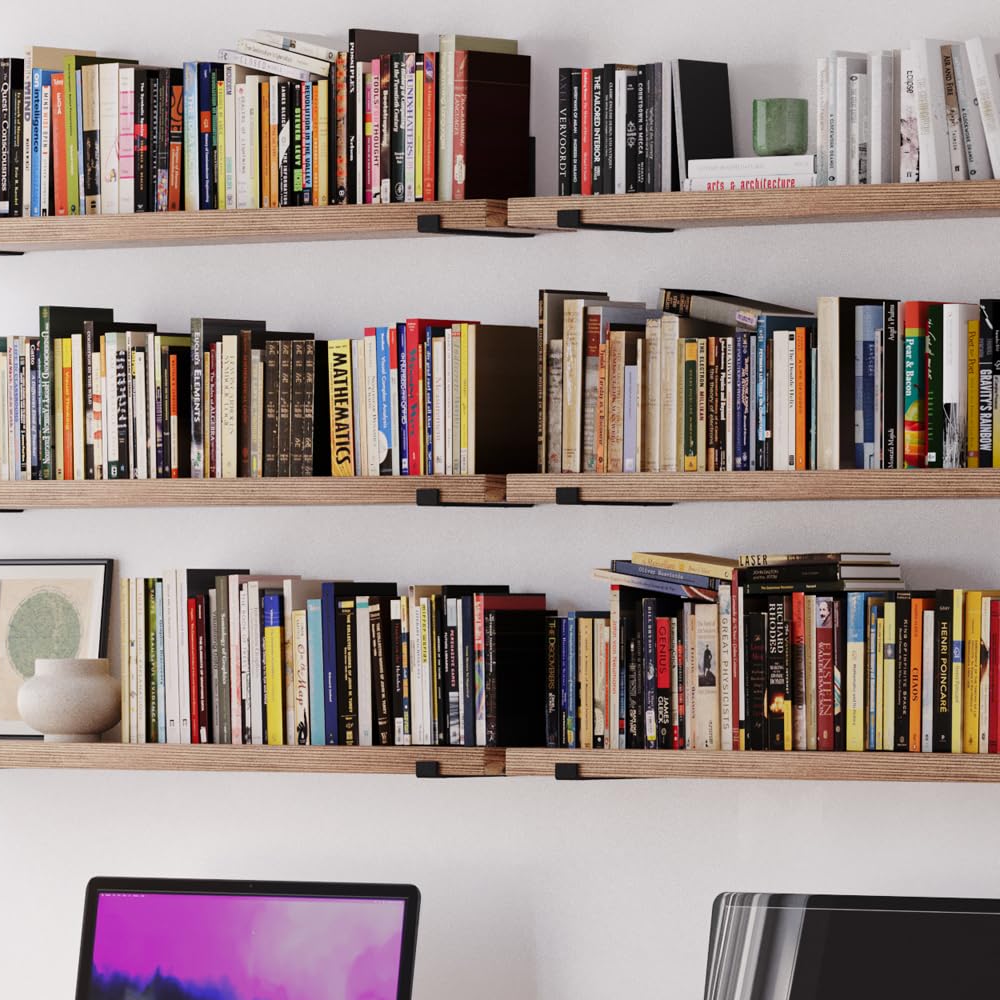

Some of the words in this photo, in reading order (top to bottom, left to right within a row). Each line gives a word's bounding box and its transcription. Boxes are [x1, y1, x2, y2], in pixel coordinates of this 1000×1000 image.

[0, 82, 9, 111] Quest
[34, 73, 40, 87] on
[946, 83, 954, 97] FIRE
[33, 89, 42, 153] intelligence
[305, 132, 311, 140] IN
[381, 90, 389, 147] Bootstrapping
[1, 120, 9, 191] Consciousness
[559, 108, 568, 177] VERVOORDT
[706, 180, 724, 192] arts
[730, 180, 736, 191] &
[740, 177, 796, 191] architecture
[905, 338, 914, 360] Pear
[969, 331, 977, 349] Poet
[905, 370, 914, 397] Bacon
[968, 358, 977, 374] Poet
[193, 369, 203, 423] ELEMENTS
[709, 404, 715, 412] of
[980, 369, 992, 410] GRAVITY'S
[333, 352, 352, 466] MATHEMATICS
[980, 412, 992, 452] RAINBOW
[738, 554, 767, 567] LASER
[549, 620, 557, 637] THE
[721, 617, 729, 655] GREAT
[776, 603, 784, 653] RICHARD
[940, 621, 948, 654] HENRI
[548, 637, 558, 690] DISCOVERERS
[658, 626, 667, 674] GENIUS
[903, 642, 908, 652] OF
[296, 669, 307, 706] Map
[722, 660, 730, 730] PHYSICISTS
[823, 642, 833, 716] EINSTEIN
[940, 658, 950, 713] POINCARÉ
